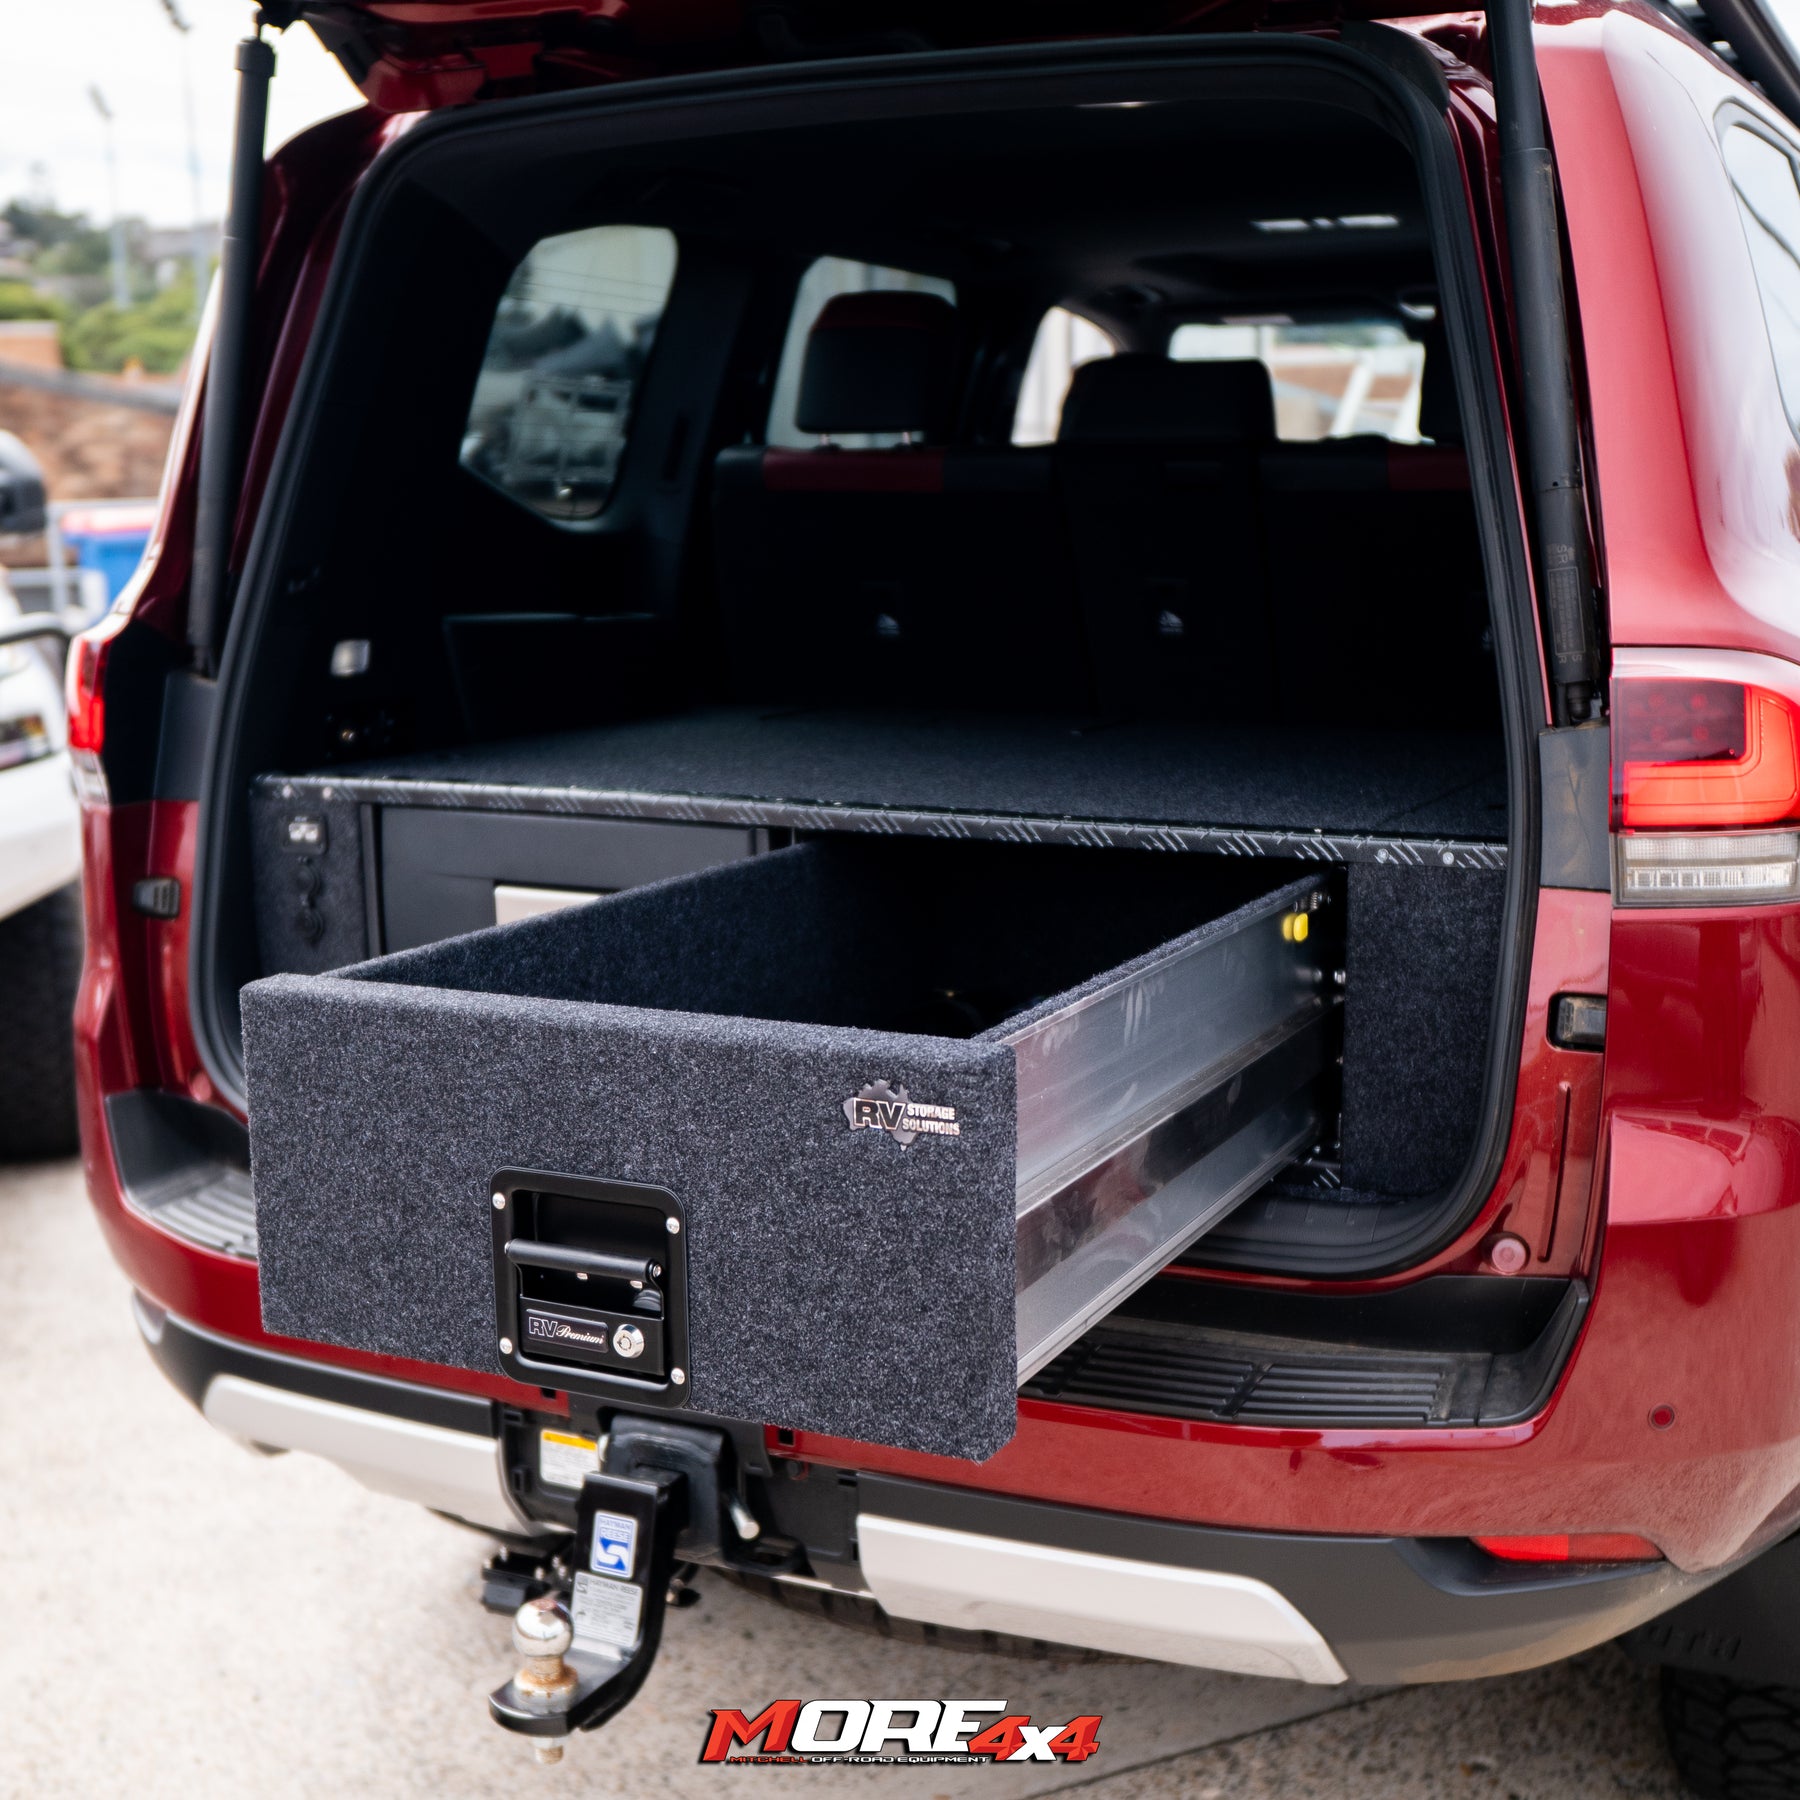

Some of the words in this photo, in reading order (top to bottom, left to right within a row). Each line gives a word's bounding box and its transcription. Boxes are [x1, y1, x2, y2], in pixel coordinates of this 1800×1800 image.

[853, 1097, 906, 1131] RV
[907, 1103, 956, 1120] STORAGE
[902, 1118, 960, 1136] SOLUTIONS
[528, 1316, 559, 1338] RV
[555, 1324, 605, 1345] Premium
